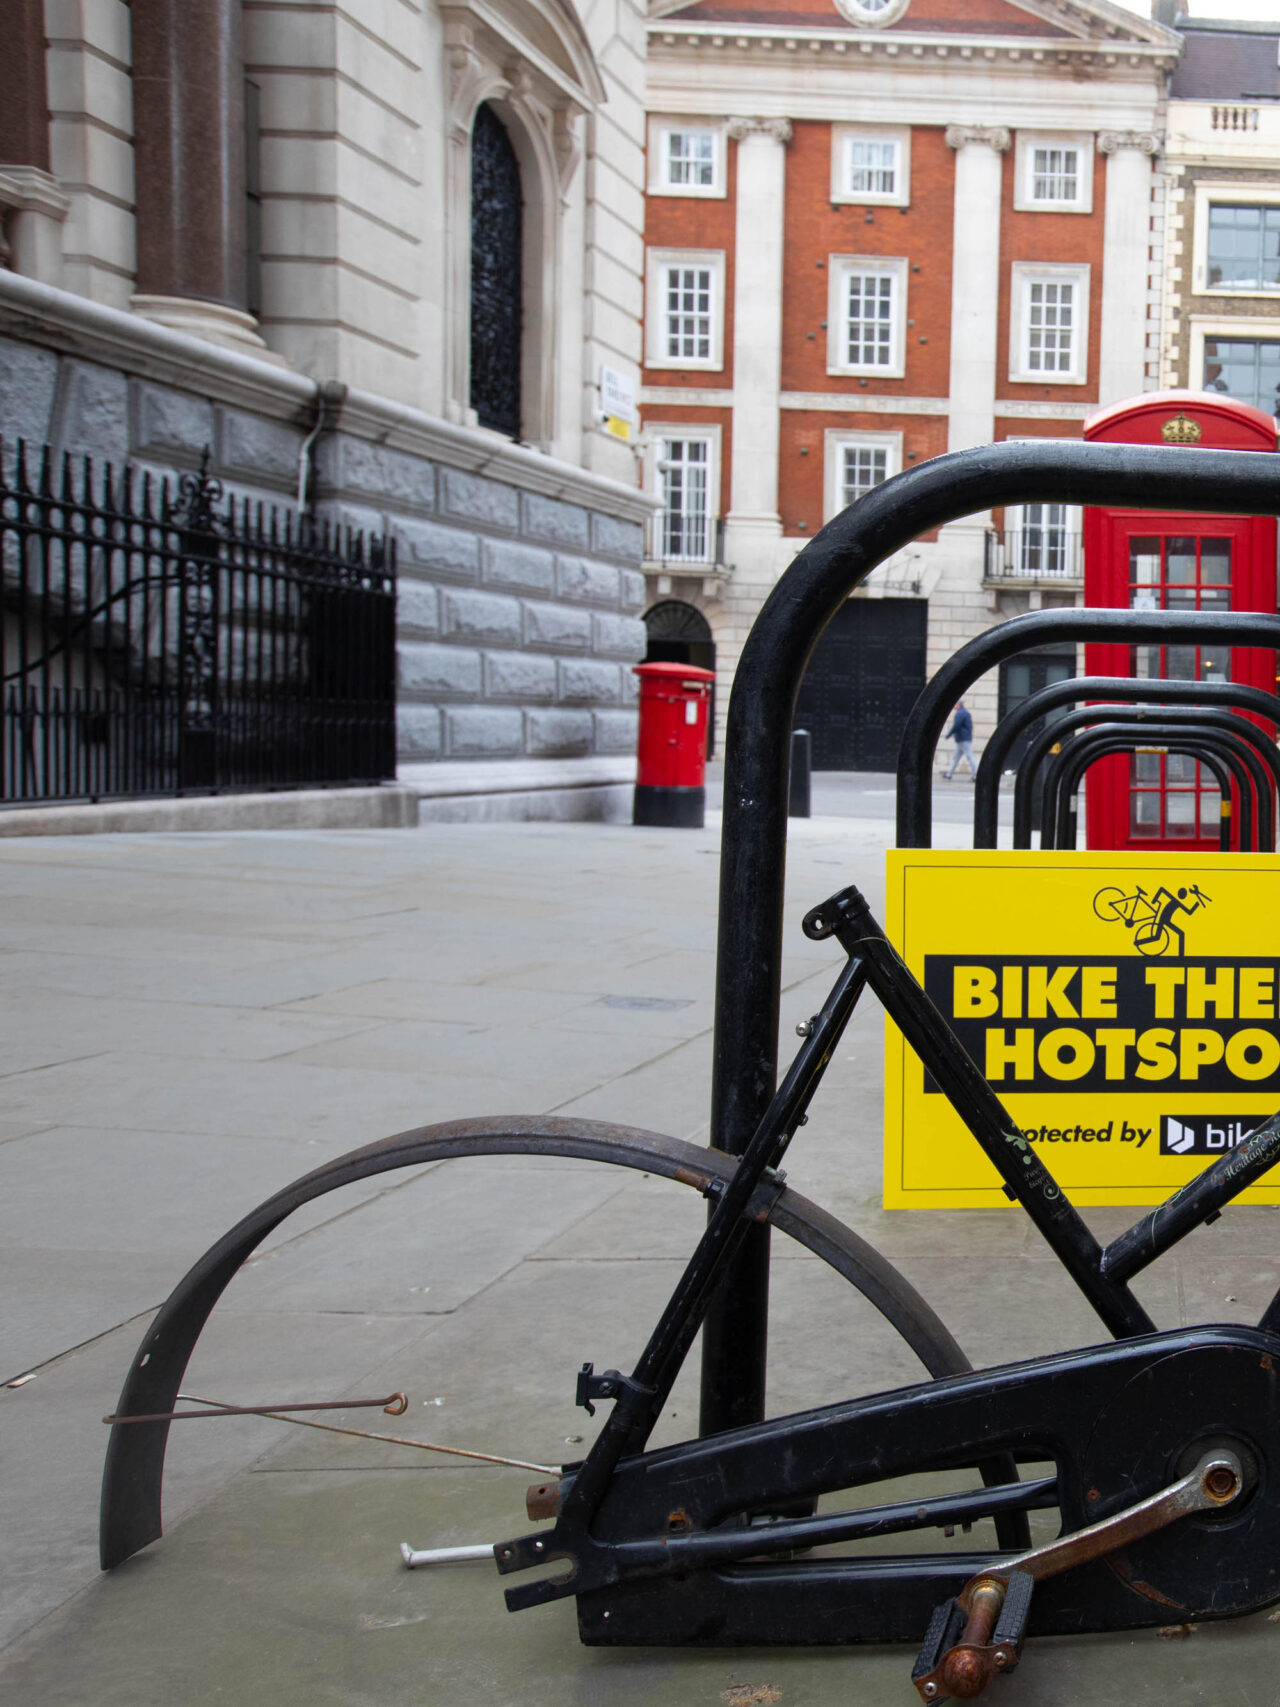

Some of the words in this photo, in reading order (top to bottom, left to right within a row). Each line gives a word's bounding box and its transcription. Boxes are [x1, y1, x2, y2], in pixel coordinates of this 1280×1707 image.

[952, 965, 1118, 1019] BIKE
[1020, 1121, 1114, 1143] otected
[1120, 1121, 1152, 1147] by
[1224, 1143, 1268, 1180] Heritage
